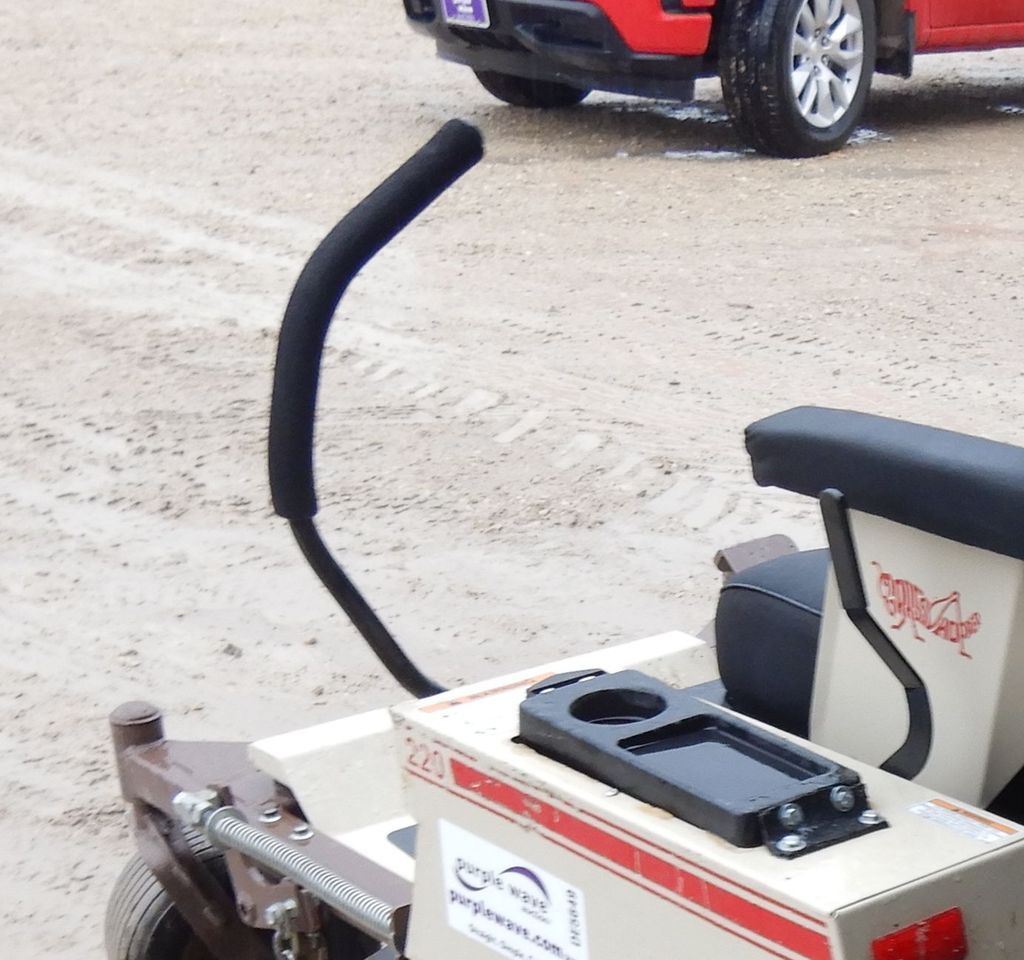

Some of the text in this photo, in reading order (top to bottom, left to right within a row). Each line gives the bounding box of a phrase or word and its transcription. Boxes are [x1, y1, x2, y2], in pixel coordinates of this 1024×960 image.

[406, 738, 446, 779] 220
[456, 857, 548, 914] purple wave
[450, 889, 564, 959] purplewave.com
